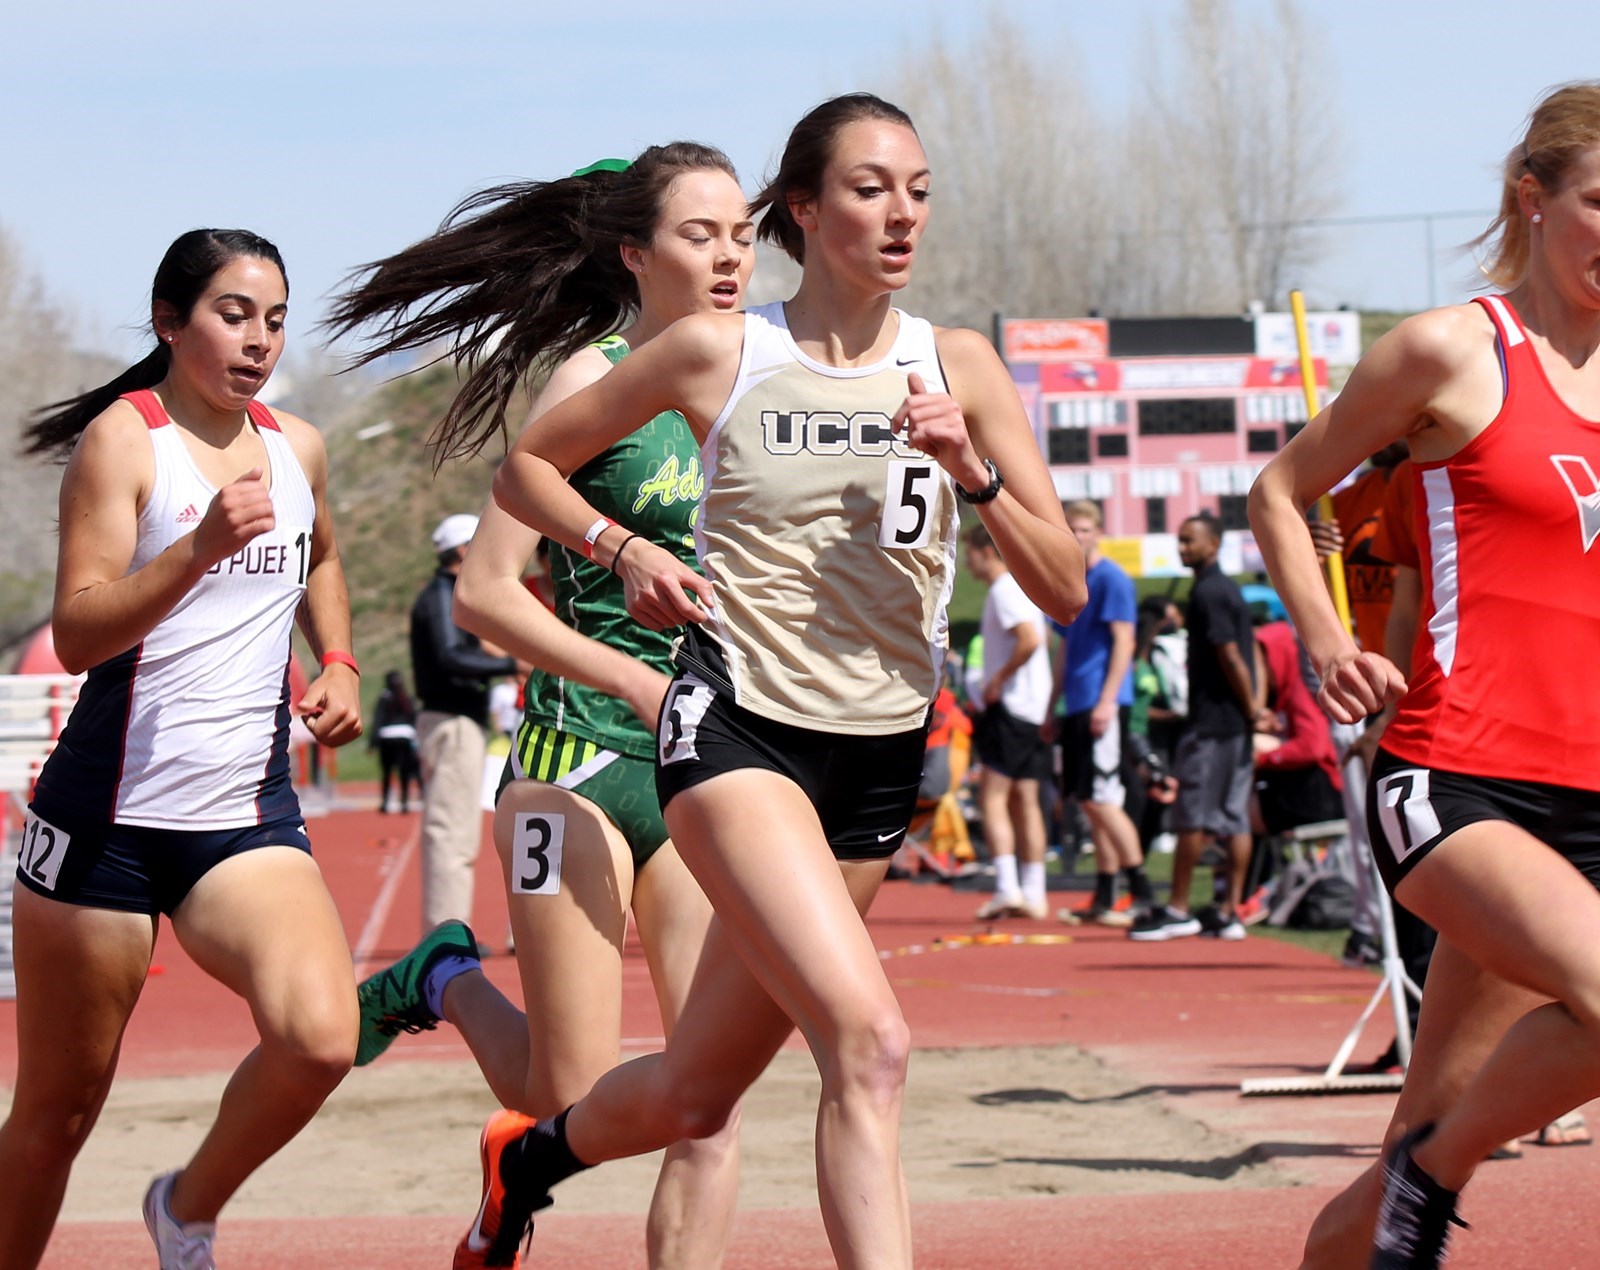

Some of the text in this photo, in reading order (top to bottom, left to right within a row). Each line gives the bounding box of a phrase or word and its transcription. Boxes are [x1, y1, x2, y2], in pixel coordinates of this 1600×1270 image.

[632, 454, 704, 514] Ad
[895, 467, 931, 544] 5
[295, 532, 313, 585] 1
[663, 684, 696, 759] 5
[1384, 774, 1414, 852] 7
[26, 819, 56, 883] 12
[521, 817, 552, 890] 3
